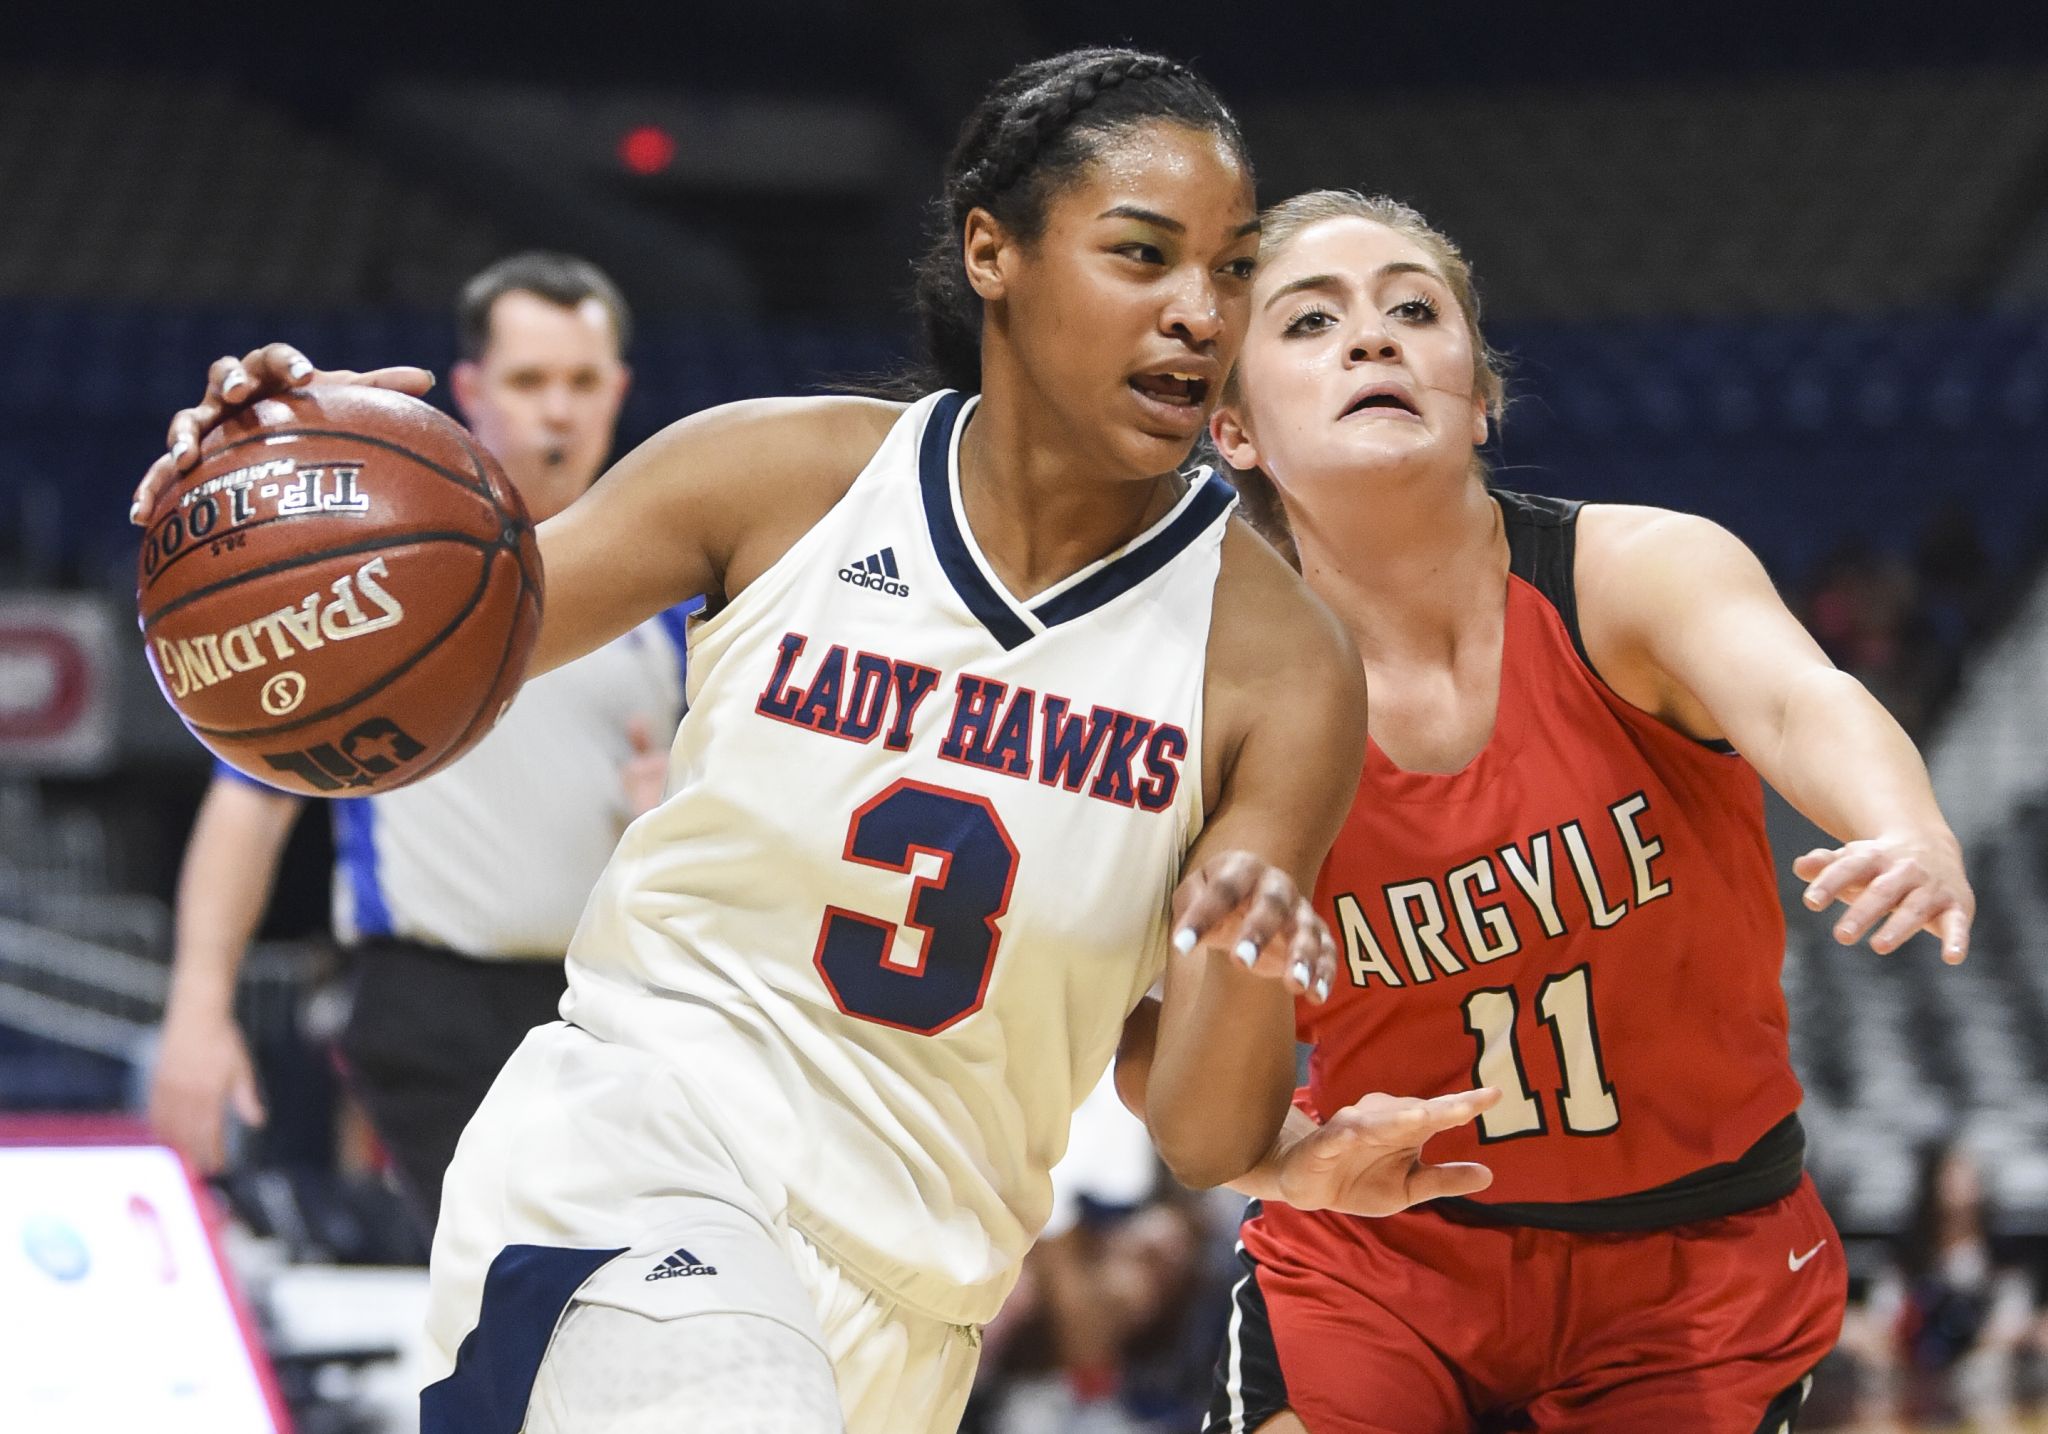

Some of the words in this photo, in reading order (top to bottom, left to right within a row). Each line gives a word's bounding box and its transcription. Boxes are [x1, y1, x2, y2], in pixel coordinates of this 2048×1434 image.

[144, 467, 370, 577] TF-1000
[837, 568, 910, 598] adidas
[156, 556, 405, 699] SPALDING
[754, 632, 943, 753] LADY
[937, 672, 1188, 814] HAWKS
[812, 776, 1022, 1038] 3
[1333, 789, 1673, 988] ARGYLE
[1461, 961, 1622, 1146] 11
[644, 1264, 718, 1282] adidas
